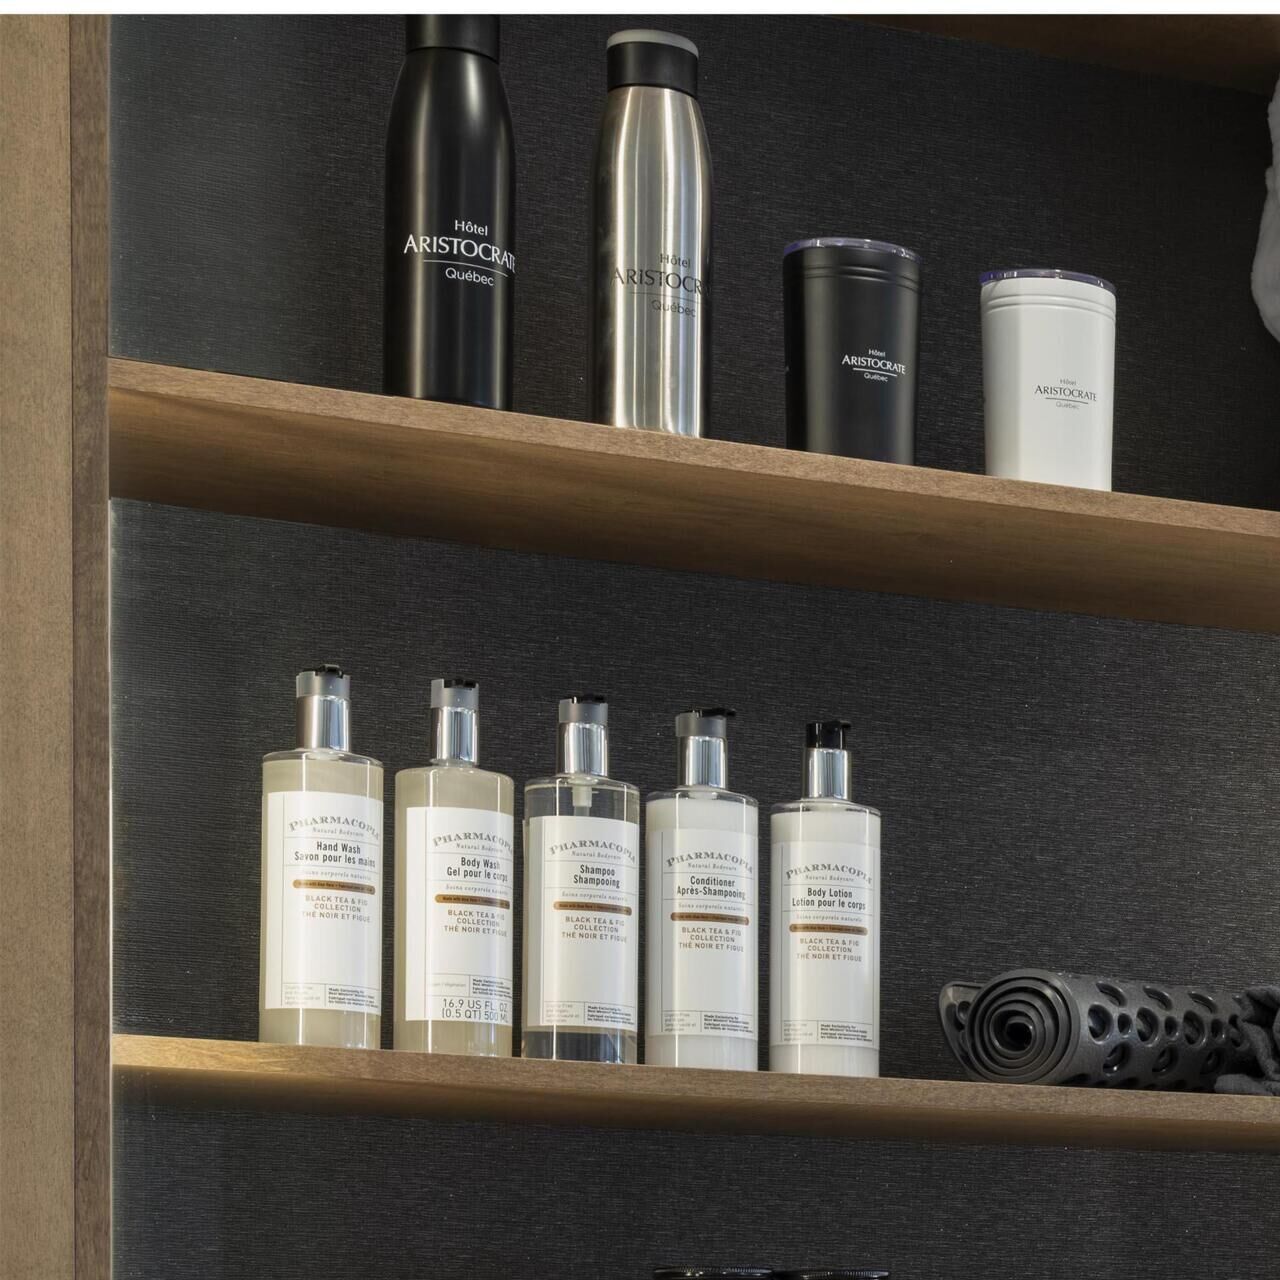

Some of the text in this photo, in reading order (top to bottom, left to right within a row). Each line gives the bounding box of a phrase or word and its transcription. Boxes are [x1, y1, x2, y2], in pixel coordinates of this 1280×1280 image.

[455, 220, 488, 236] Hôtel
[660, 252, 691, 269] Hôtel
[445, 267, 494, 286] Québec
[651, 300, 697, 318] Québec
[868, 348, 886, 358] Hôtel
[841, 354, 906, 375] ARISTOCRATE
[863, 371, 889, 383] Québec
[1034, 384, 1097, 402] ARISTOCRATE
[316, 841, 361, 854] Hand Wash
[294, 851, 376, 868] Savon pour les mains
[461, 857, 480, 869] Body
[447, 866, 491, 879] Gel pour le
[580, 864, 616, 877] Shampoo
[573, 874, 621, 889] Shampooing
[690, 875, 736, 887] Conditioner
[677, 886, 746, 900] Après-Shampooing
[807, 887, 853, 899] Body Lotion
[792, 897, 866, 910] Lotion pour le corps
[443, 998, 482, 1010] 16.9 US
